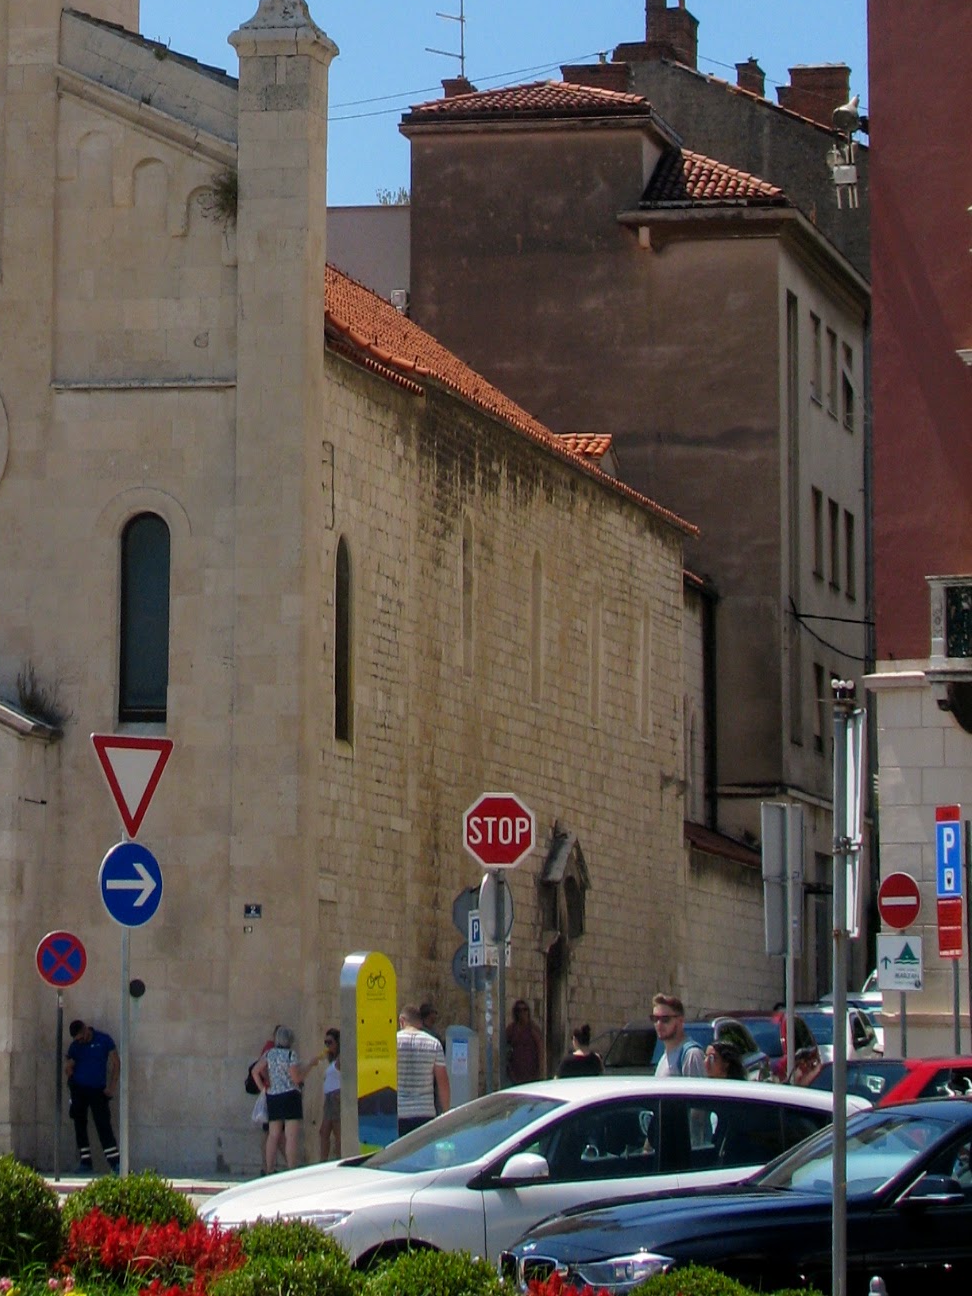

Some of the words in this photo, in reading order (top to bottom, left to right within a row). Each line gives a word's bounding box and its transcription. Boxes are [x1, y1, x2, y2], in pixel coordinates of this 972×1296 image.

[469, 816, 530, 845] STOP
[943, 827, 955, 864] P
[473, 921, 479, 941] P
